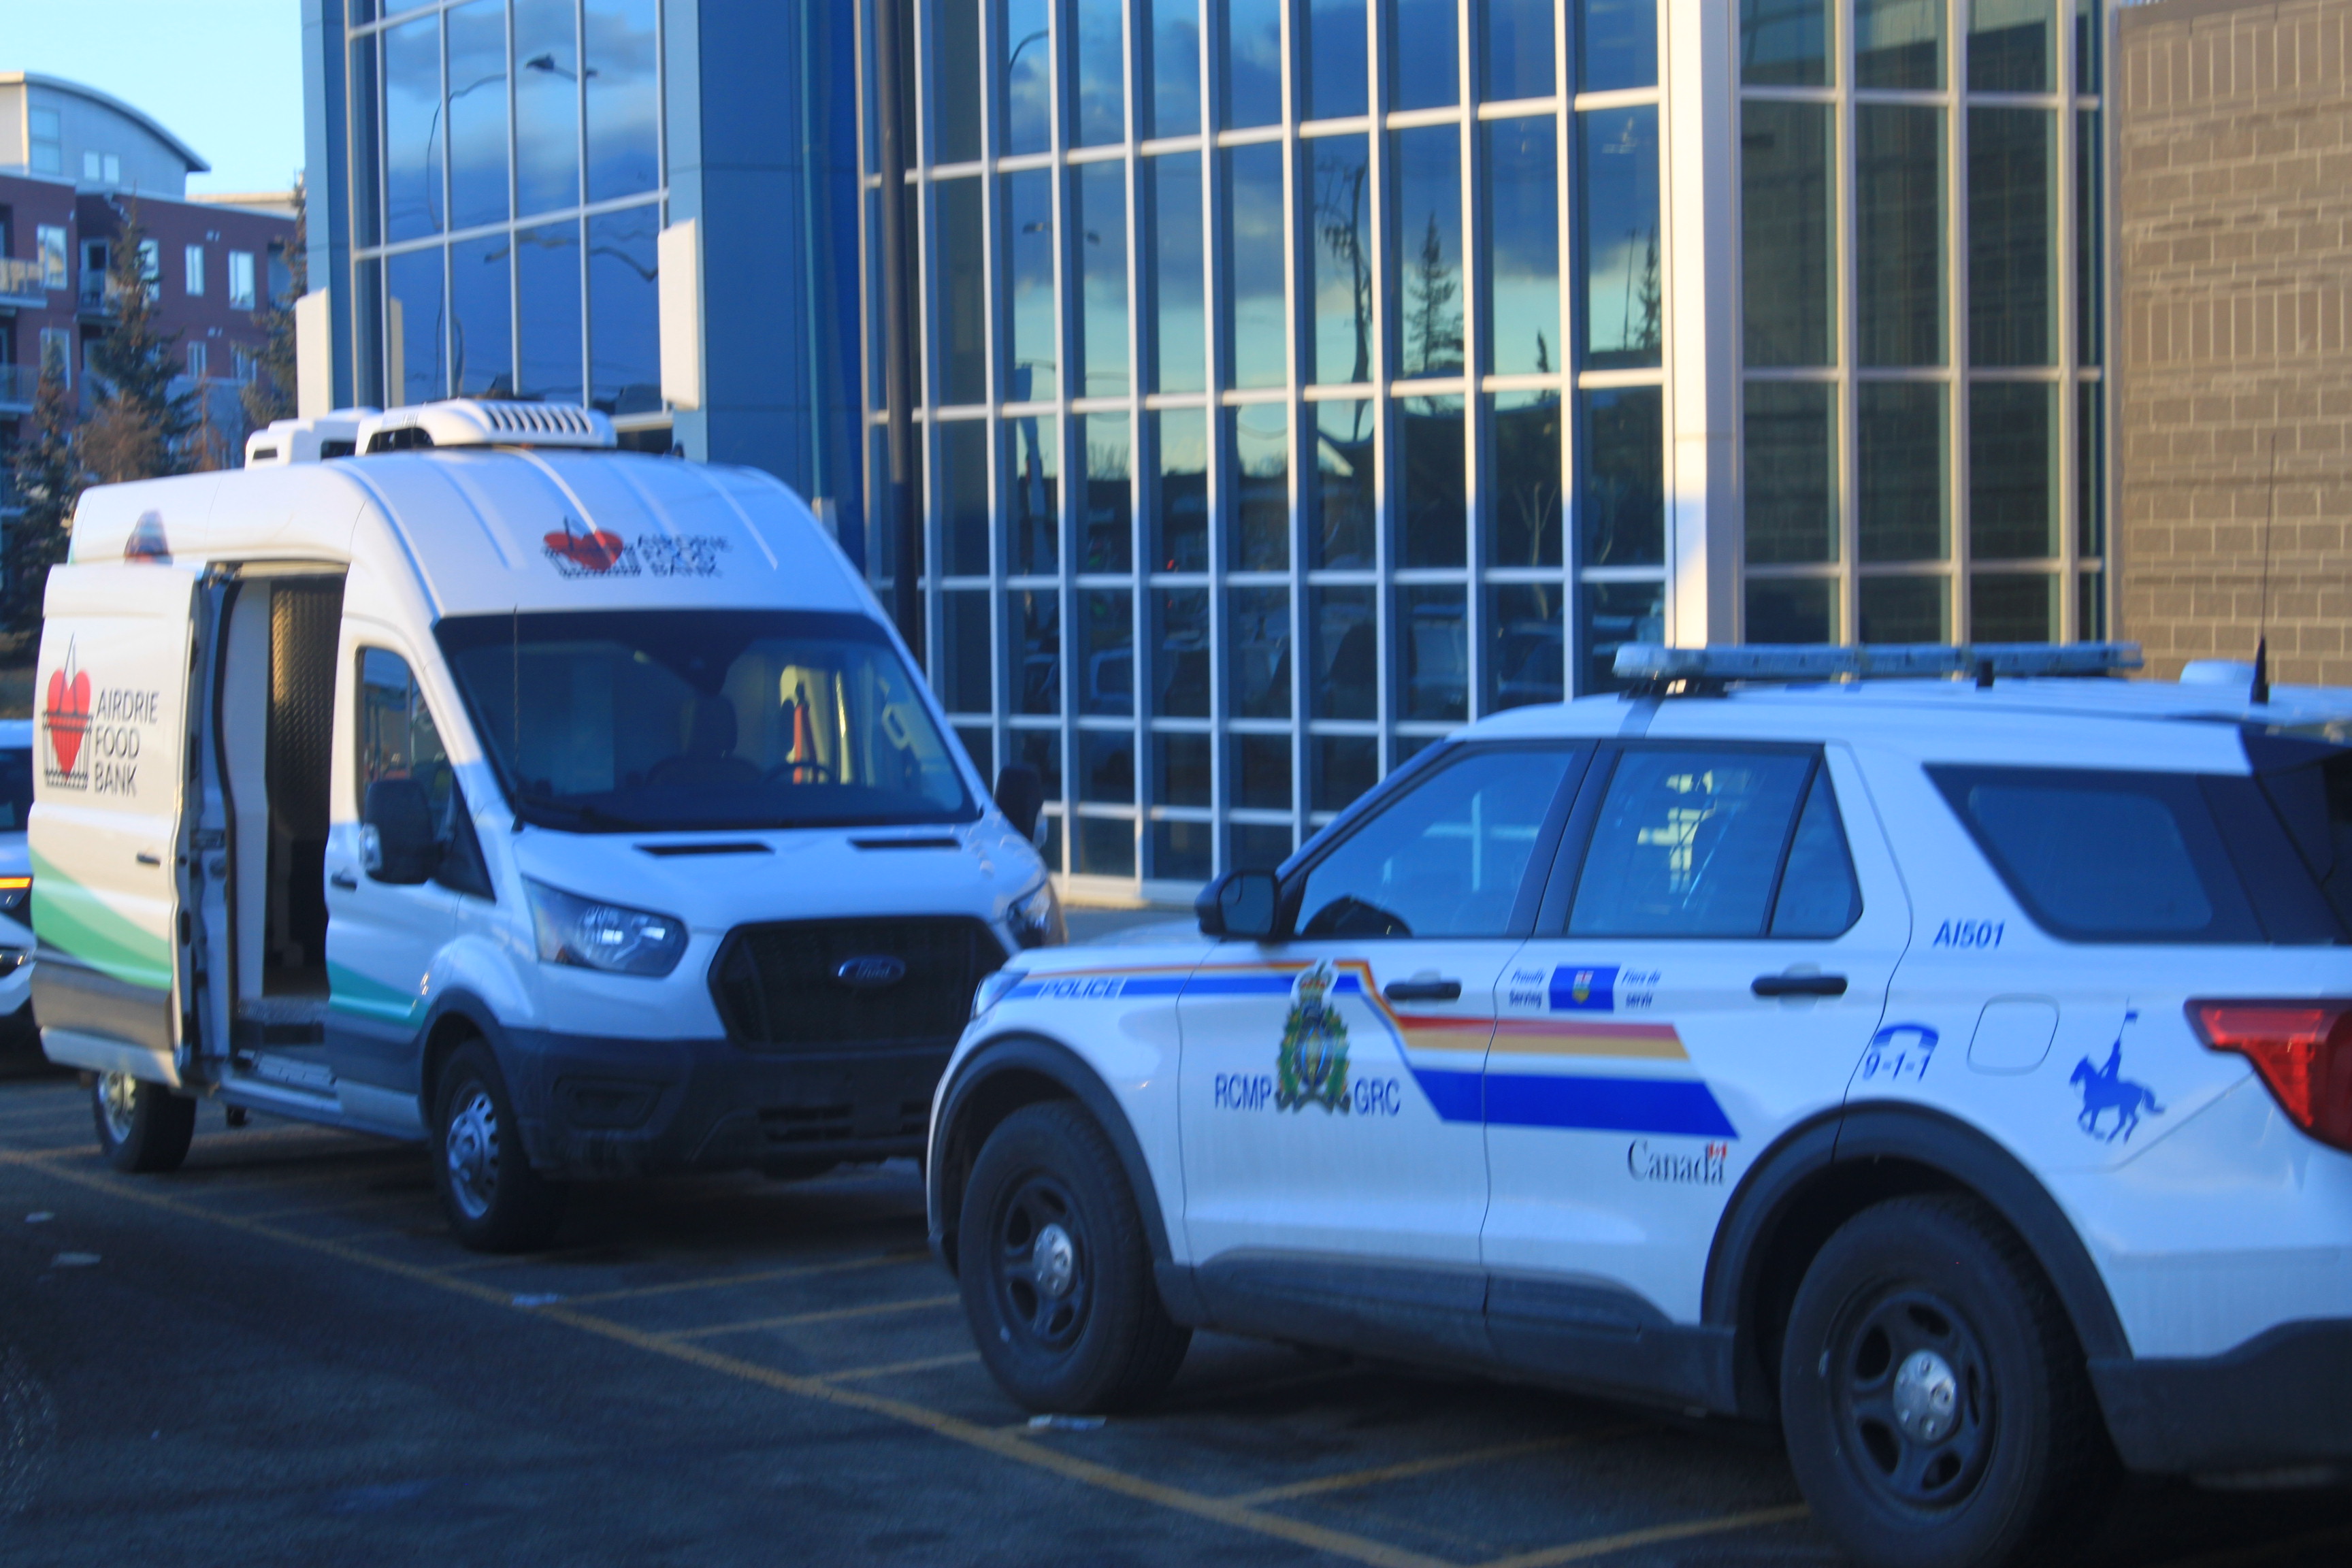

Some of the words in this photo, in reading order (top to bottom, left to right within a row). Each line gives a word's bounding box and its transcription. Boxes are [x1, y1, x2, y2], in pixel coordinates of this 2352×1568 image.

[96, 688, 159, 723] AIRDRIE
[95, 725, 140, 758] FOOD
[95, 762, 137, 798] BANK
[1932, 919, 2005, 949] AI501
[1036, 977, 1128, 1000] POLICE
[1215, 1073, 1272, 1113] RCMP
[1354, 1077, 1401, 1116] GRC
[1627, 1138, 1725, 1185] Canada
